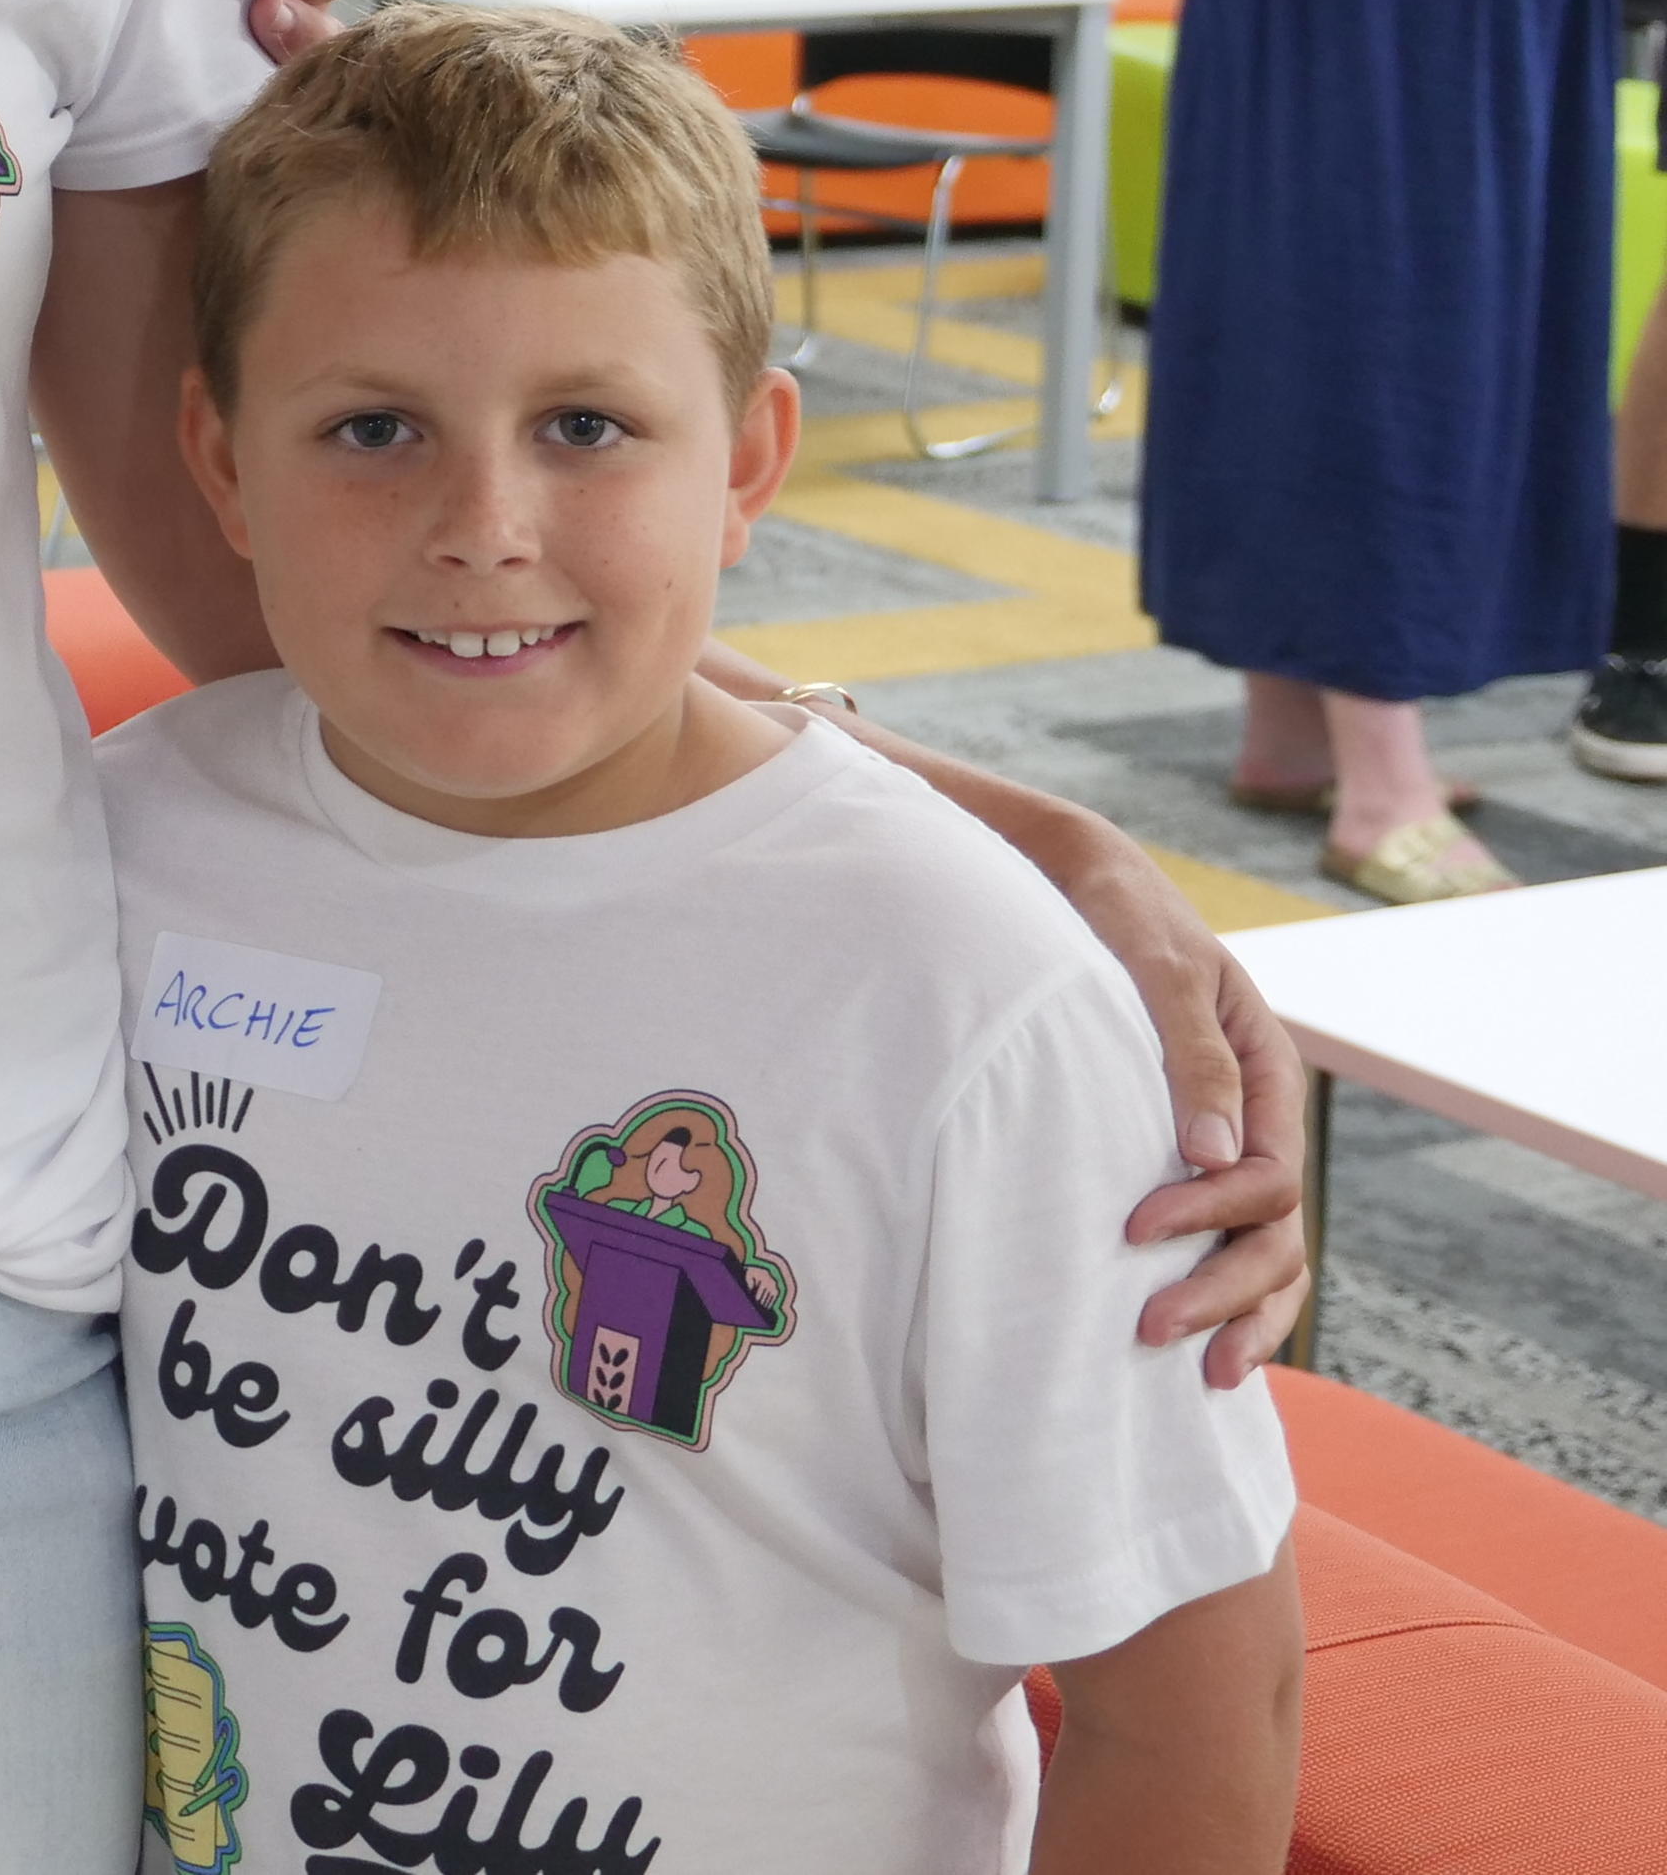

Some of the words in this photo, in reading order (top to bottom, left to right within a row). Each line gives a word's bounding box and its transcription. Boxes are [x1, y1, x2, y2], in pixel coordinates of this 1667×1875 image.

[154, 969, 336, 1048] ARCHIE
[131, 1143, 522, 1372] Don't
[157, 1298, 291, 1449] be
[330, 1377, 626, 1576] silly
[394, 1551, 625, 1713] for
